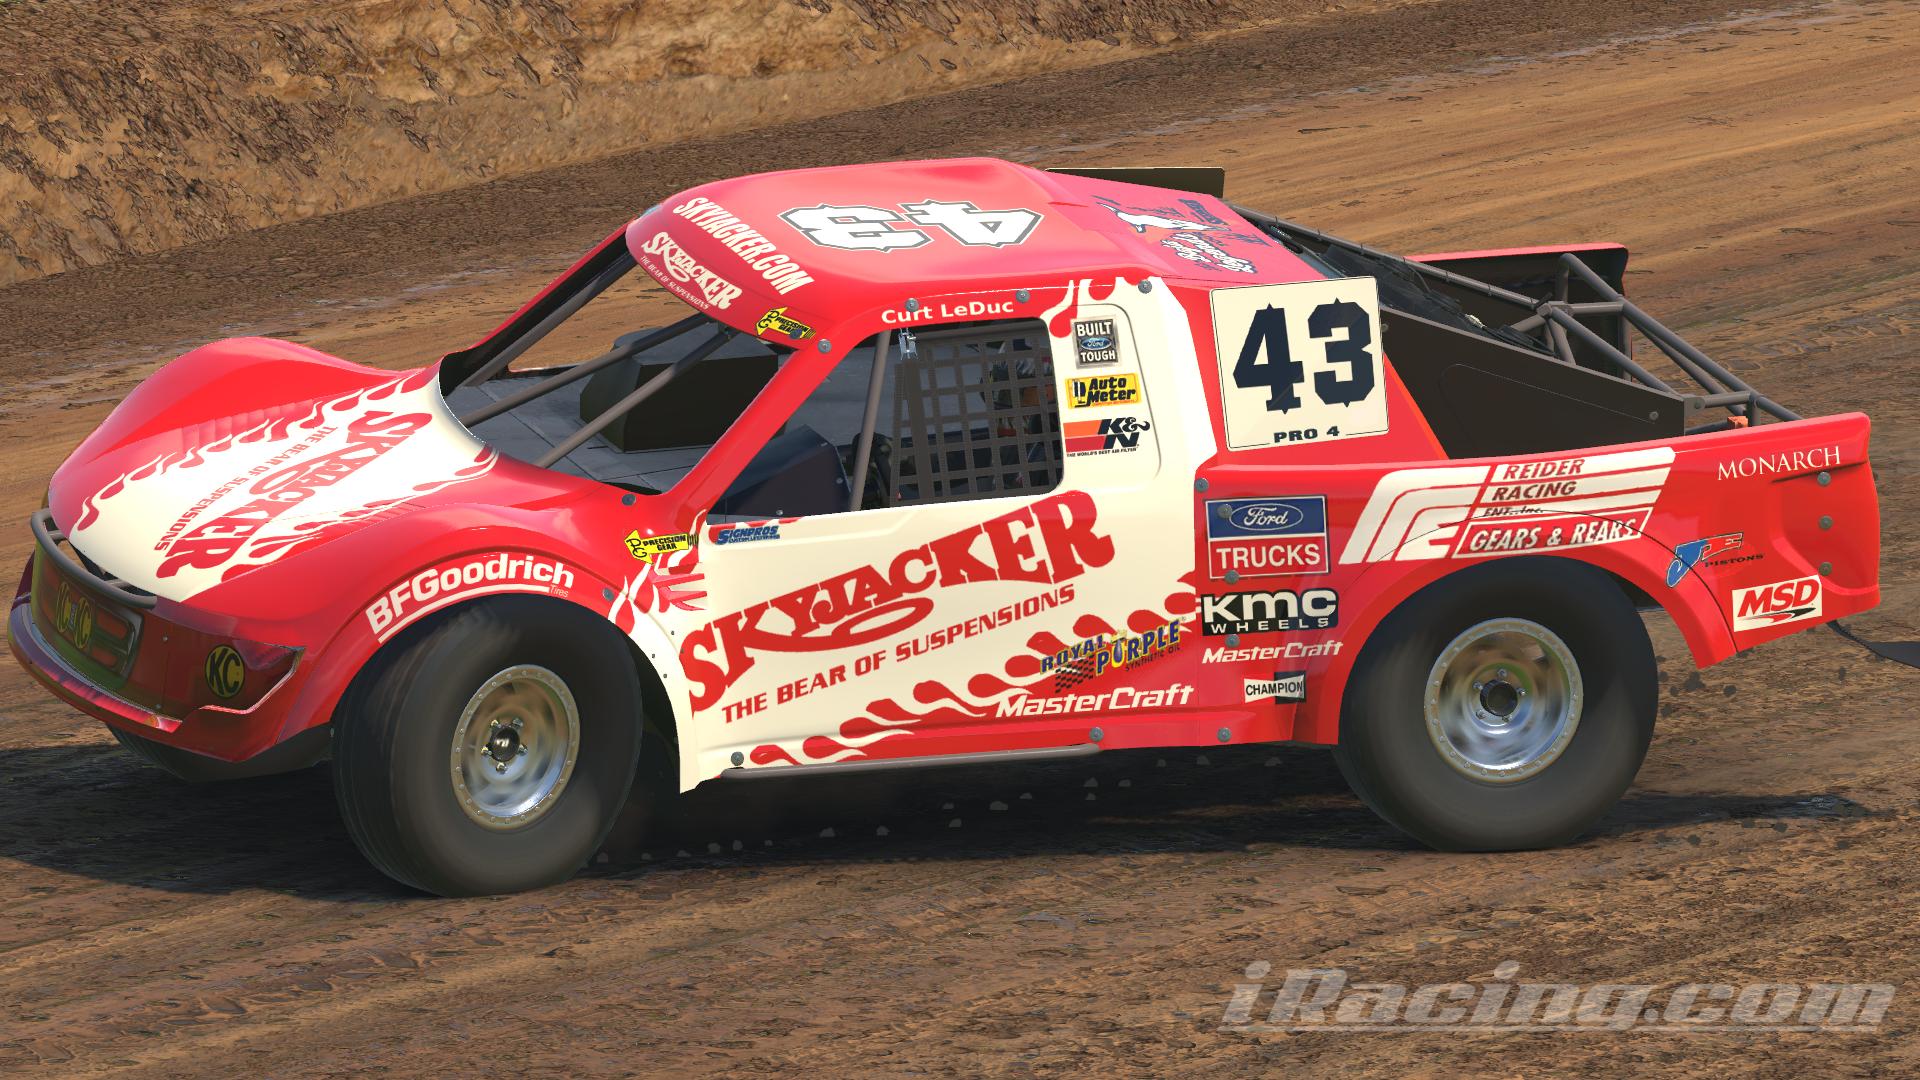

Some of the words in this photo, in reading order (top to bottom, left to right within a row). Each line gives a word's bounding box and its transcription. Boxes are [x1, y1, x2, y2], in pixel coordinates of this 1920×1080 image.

[777, 198, 1045, 253] 43
[672, 197, 815, 296] SKYJACKER.COM
[641, 231, 743, 310] SKYJACKER
[881, 306, 934, 324] Curt
[940, 301, 1014, 318] LeDuc
[1076, 321, 1112, 337] BUILT
[1087, 337, 1105, 347] Ford
[1080, 350, 1116, 362] TOUGH
[1233, 297, 1375, 415] 43
[1089, 377, 1127, 391] Auto
[1086, 389, 1136, 406] Meter
[304, 426, 339, 443] THE
[1273, 428, 1318, 443] PRO
[1326, 426, 1340, 437] 4
[264, 443, 311, 466] BEAR
[1717, 446, 1841, 480] MONARCH
[248, 465, 271, 476] OF
[1503, 459, 1586, 480] REIDER
[155, 410, 433, 579] SKYJACKER
[1492, 481, 1577, 501] RACING
[154, 476, 250, 551] SUSPENSIONS
[1244, 506, 1289, 525] Ford
[643, 535, 687, 546] PRECISION
[1470, 527, 1542, 551] GEARS
[1547, 528, 1562, 546] &
[1571, 518, 1636, 544] REARS
[656, 542, 678, 551] GEAR
[1216, 543, 1321, 569] TRUCKS
[1704, 553, 1765, 568] PISTONS
[365, 553, 575, 635] BFGoodrich
[550, 584, 569, 598] Tires
[1737, 579, 1822, 618] MSD
[680, 490, 1116, 719] SKYJACKER
[1211, 617, 1329, 634] WHEELS
[722, 692, 768, 724] THE
[777, 664, 847, 705] BEAR
[854, 650, 887, 677] OF
[896, 583, 1076, 663] SUSPENSIONS
[1040, 633, 1107, 675] ROYAL
[1095, 618, 1181, 676] PURPLE
[1202, 640, 1343, 664] MasterCraft
[208, 647, 241, 695] KC
[1246, 680, 1304, 696] CHAMPION
[995, 683, 1194, 718] MasterCraft
